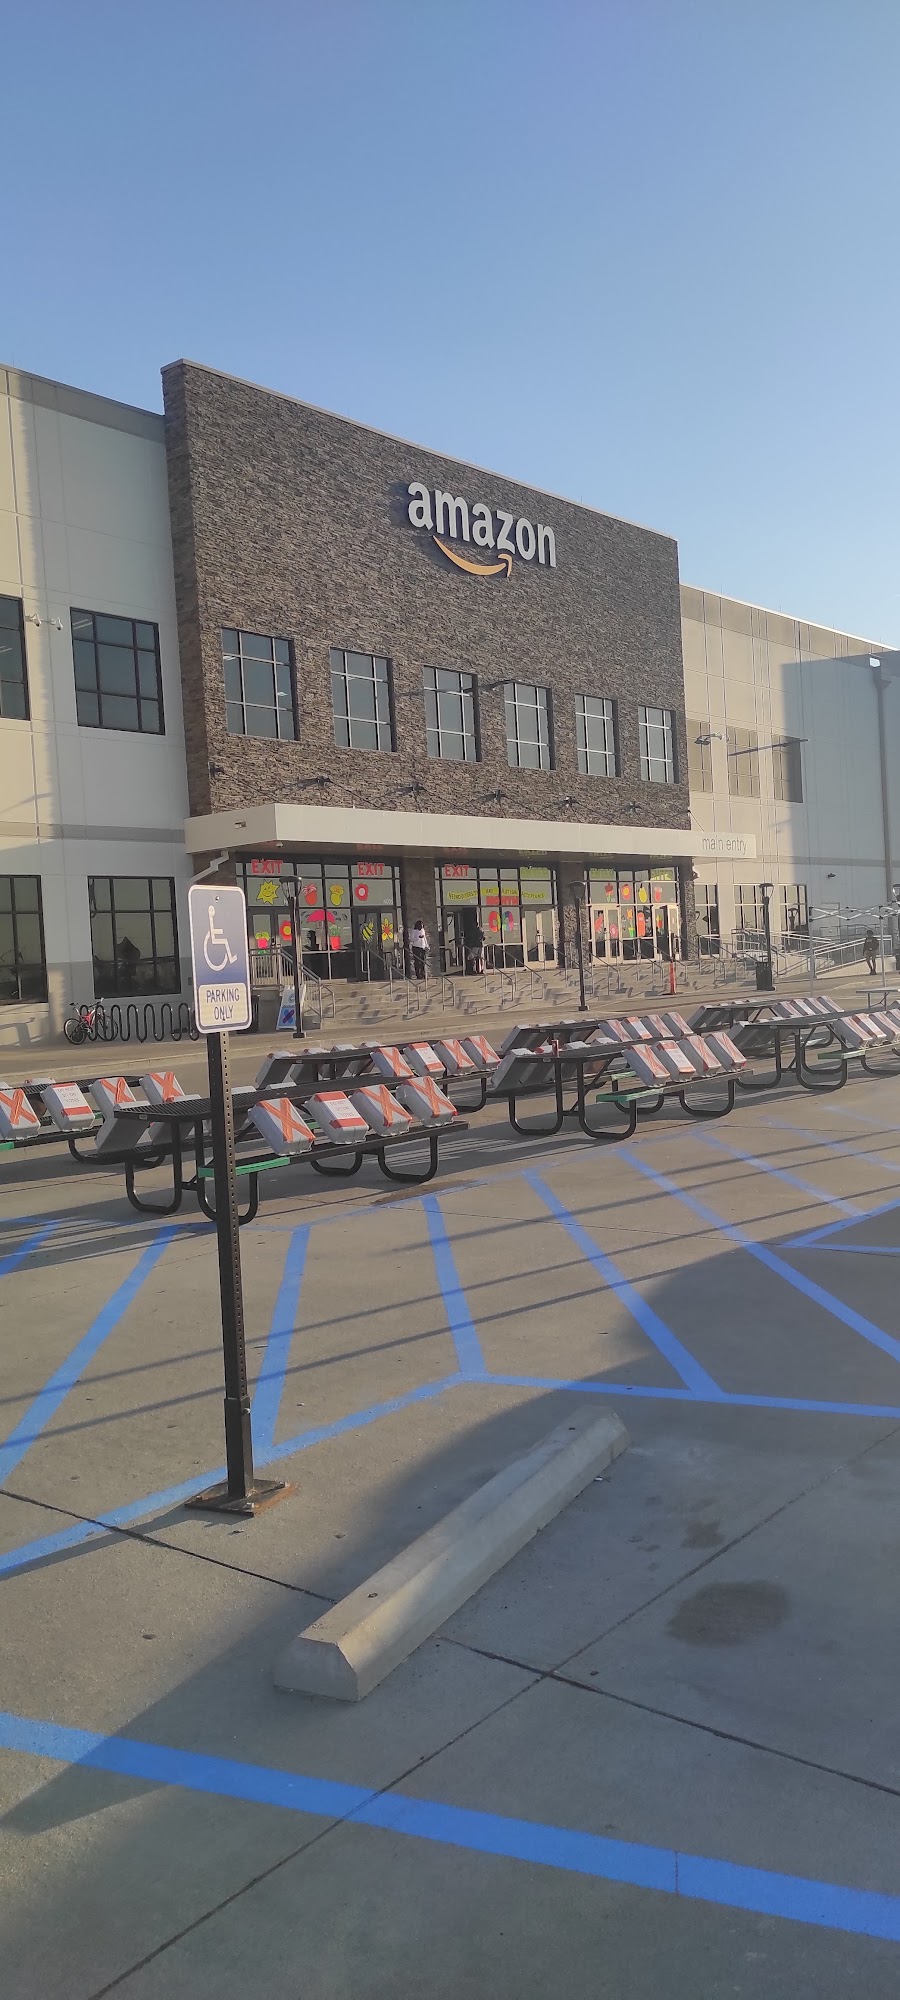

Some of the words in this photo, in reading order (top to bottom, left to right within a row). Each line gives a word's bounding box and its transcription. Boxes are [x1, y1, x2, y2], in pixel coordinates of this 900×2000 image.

[408, 482, 556, 567] amazon
[702, 835, 723, 850] main
[726, 836, 747, 855] entry
[251, 859, 283, 874] EXIT
[357, 862, 385, 876] EXIT
[444, 864, 469, 877] EXIT
[206, 988, 240, 1003] PARKING
[213, 1005, 234, 1020] ONLY
